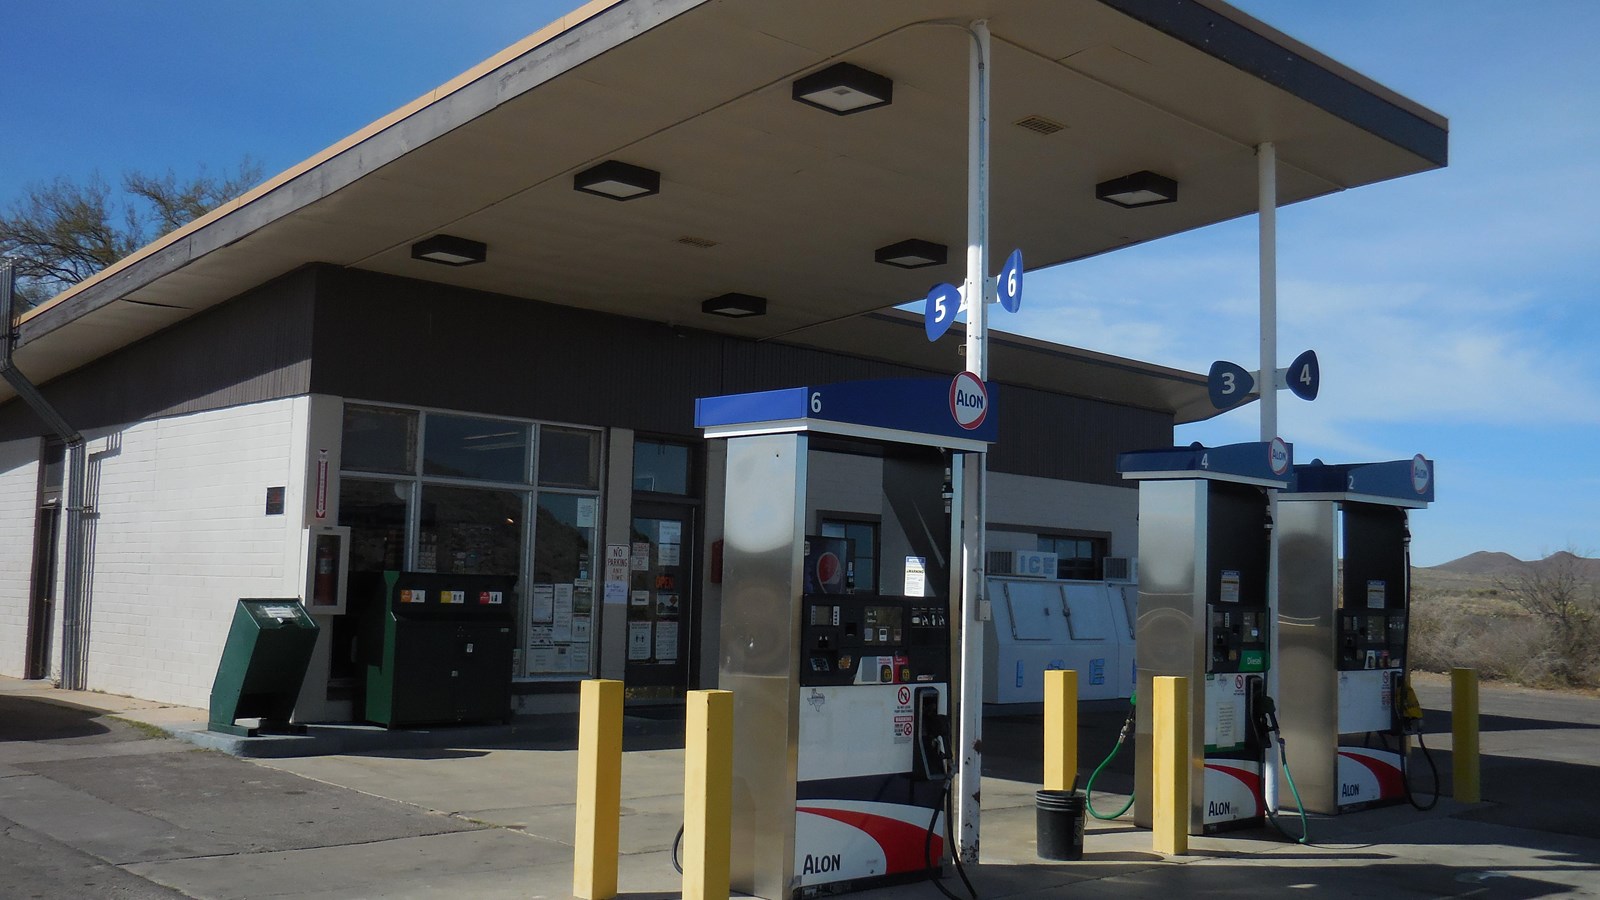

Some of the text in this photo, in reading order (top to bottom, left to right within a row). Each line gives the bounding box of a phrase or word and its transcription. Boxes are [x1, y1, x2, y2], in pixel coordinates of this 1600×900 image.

[1007, 268, 1017, 297] 6
[934, 295, 946, 323] 5
[1221, 372, 1236, 395] 3
[1299, 363, 1312, 386] 4
[811, 391, 822, 413] 6
[1201, 452, 1209, 469] 4
[1348, 475, 1354, 490] 2
[607, 558, 628, 568] PARKING
[613, 548, 623, 558] NO
[1020, 555, 1055, 576] ICE
[1246, 656, 1262, 665] Diesel
